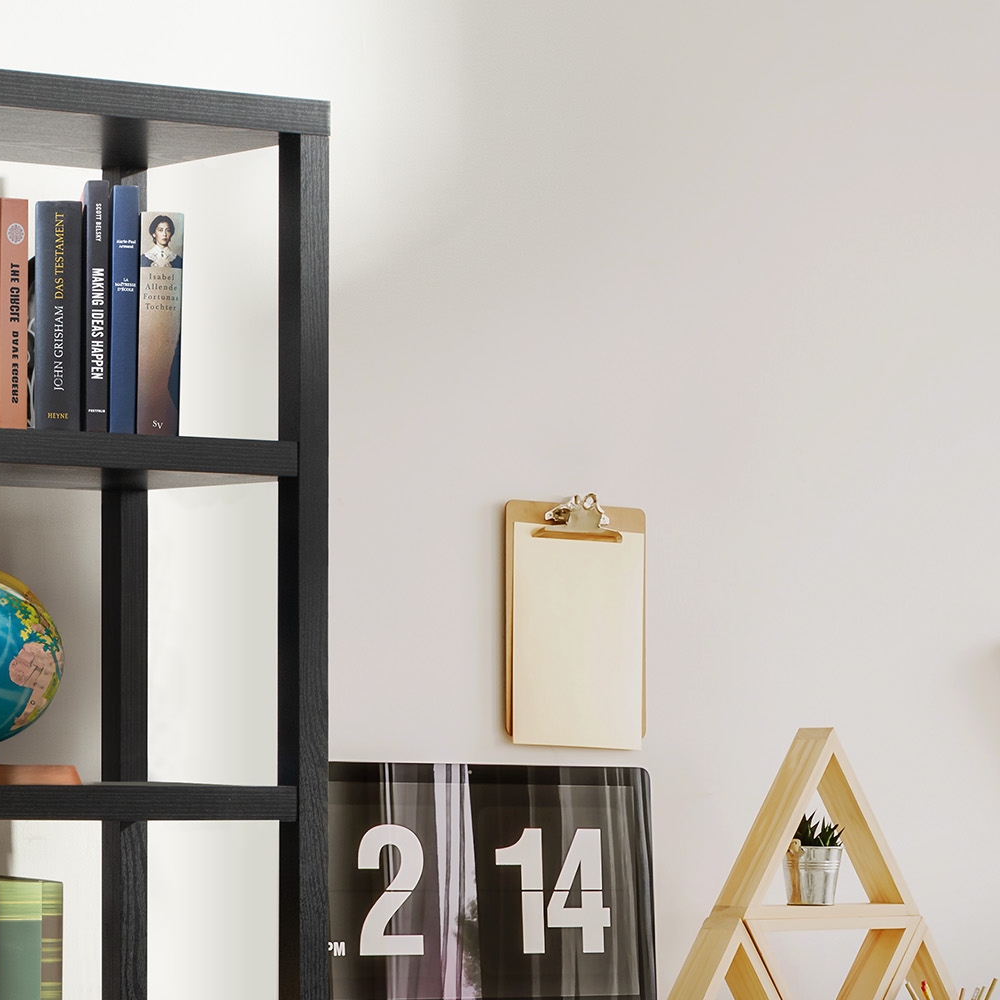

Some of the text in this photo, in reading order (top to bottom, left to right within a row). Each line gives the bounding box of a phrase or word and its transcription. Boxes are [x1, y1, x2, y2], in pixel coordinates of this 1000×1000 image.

[149, 273, 175, 281] Isabel
[144, 283, 178, 291] Allende
[53, 211, 66, 391] JOHN GRISHAM DAS TESTAMENT
[143, 293, 179, 301] Fortunas
[144, 303, 177, 311] Tochter
[90, 267, 105, 380] MAKING IDEAS HAPPEN
[47, 412, 69, 420] HEYNE
[357, 823, 425, 956] 2
[495, 827, 612, 954] 14
